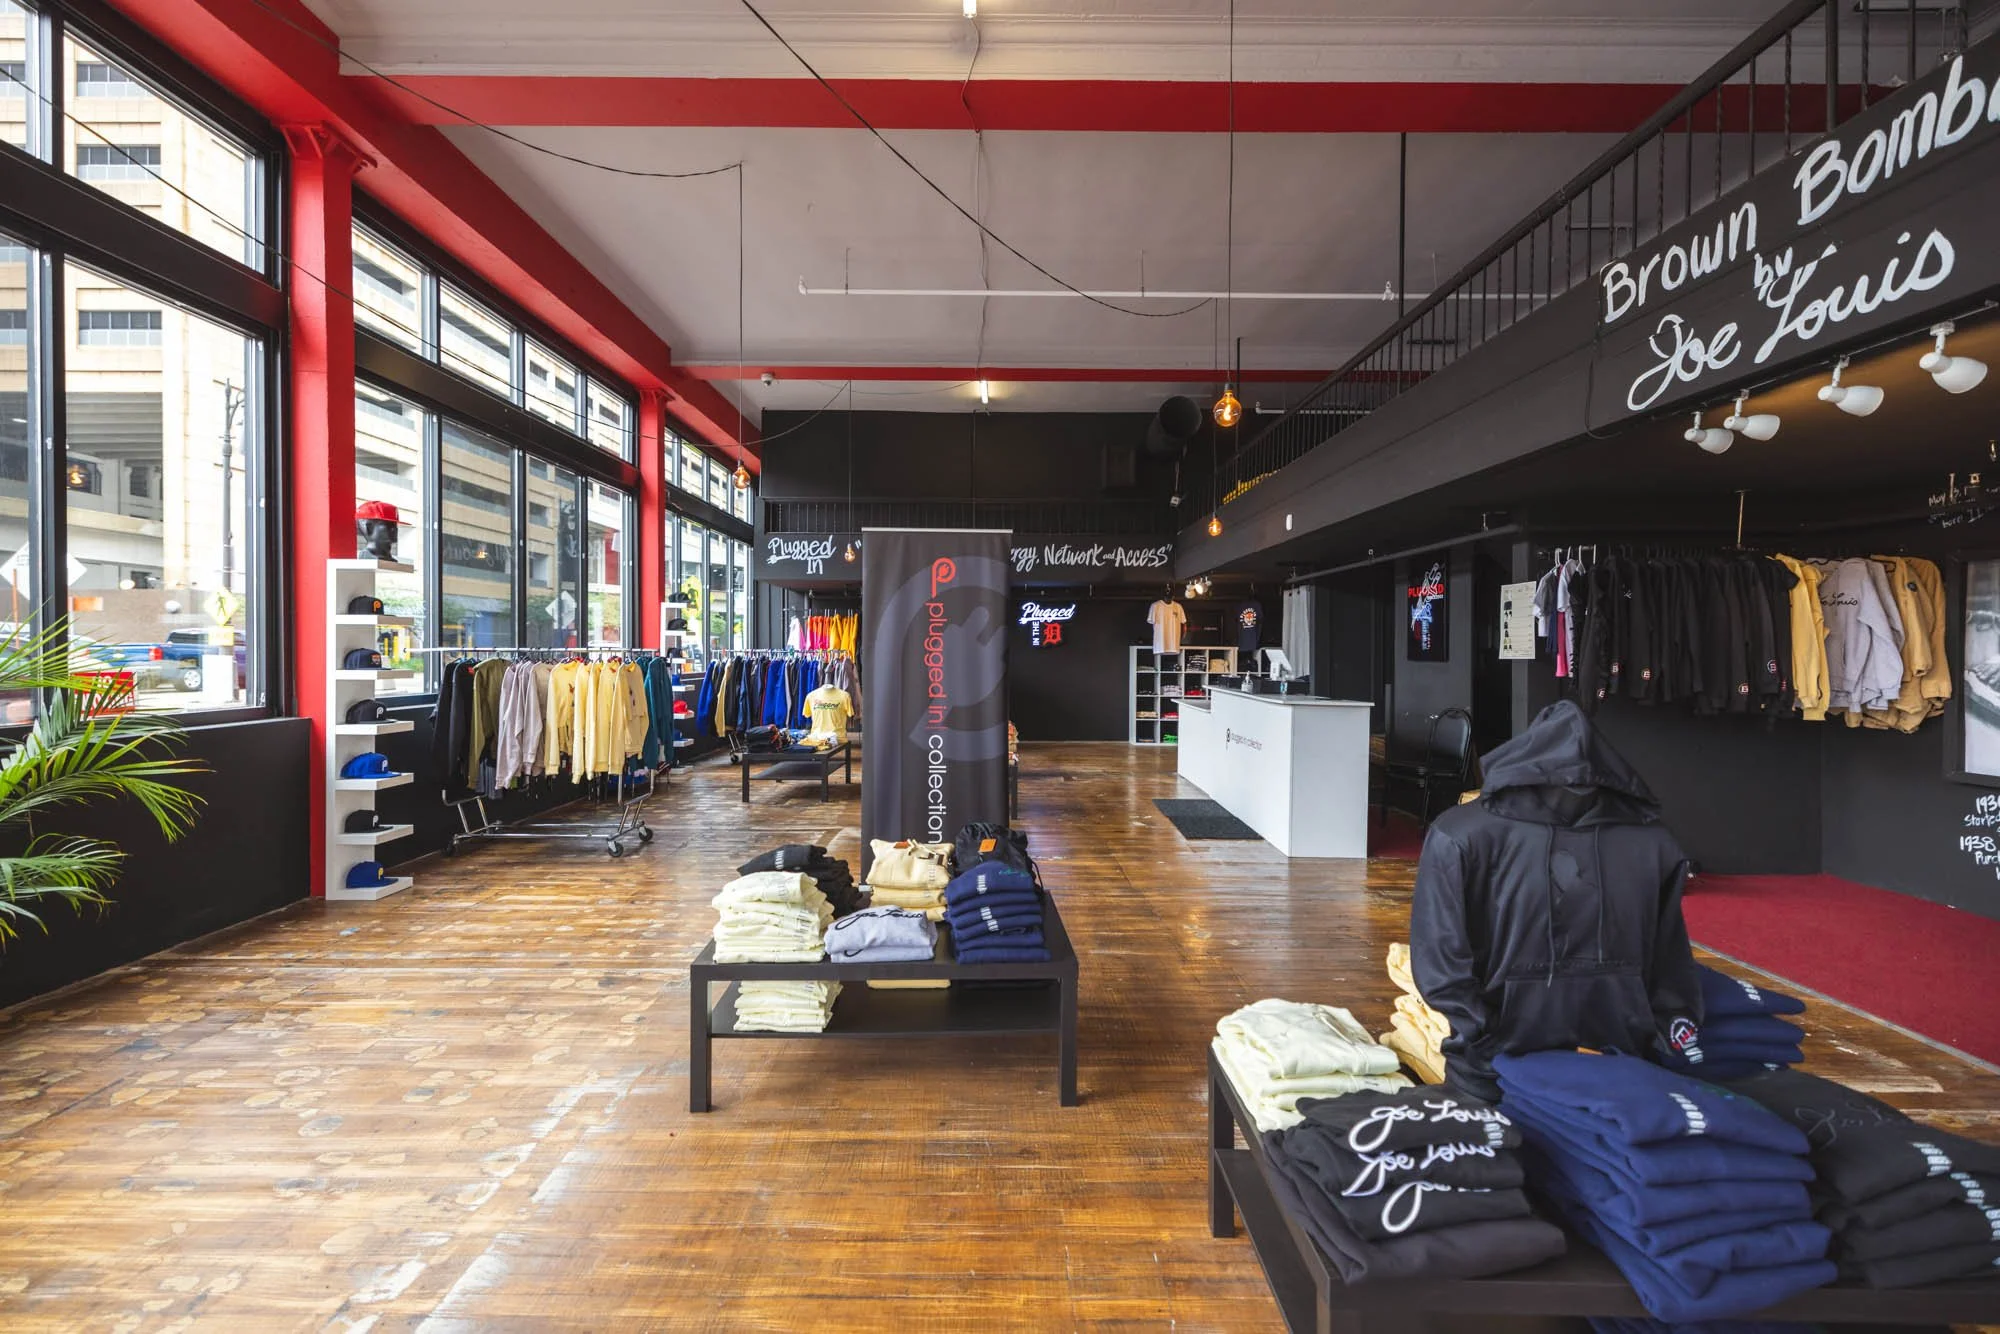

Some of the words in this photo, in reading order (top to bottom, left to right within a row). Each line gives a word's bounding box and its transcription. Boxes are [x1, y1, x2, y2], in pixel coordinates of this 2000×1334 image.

[1600, 202, 1757, 323] Brown
[1753, 245, 1794, 301] by
[1627, 314, 1741, 411] Joe
[1754, 229, 1955, 364] Louis
[766, 534, 837, 564] Plugged
[1044, 543, 1106, 567] Network
[806, 558, 824, 575] In
[1018, 601, 1076, 625] Plugged
[1032, 620, 1040, 637] THE
[1042, 622, 1062, 646] D
[923, 602, 949, 699] plugged
[1032, 637, 1040, 646] IN
[927, 705, 948, 724] in
[927, 734, 947, 844] collection
[1960, 835, 1997, 852] 1938
[1348, 1104, 1426, 1153] Joe
